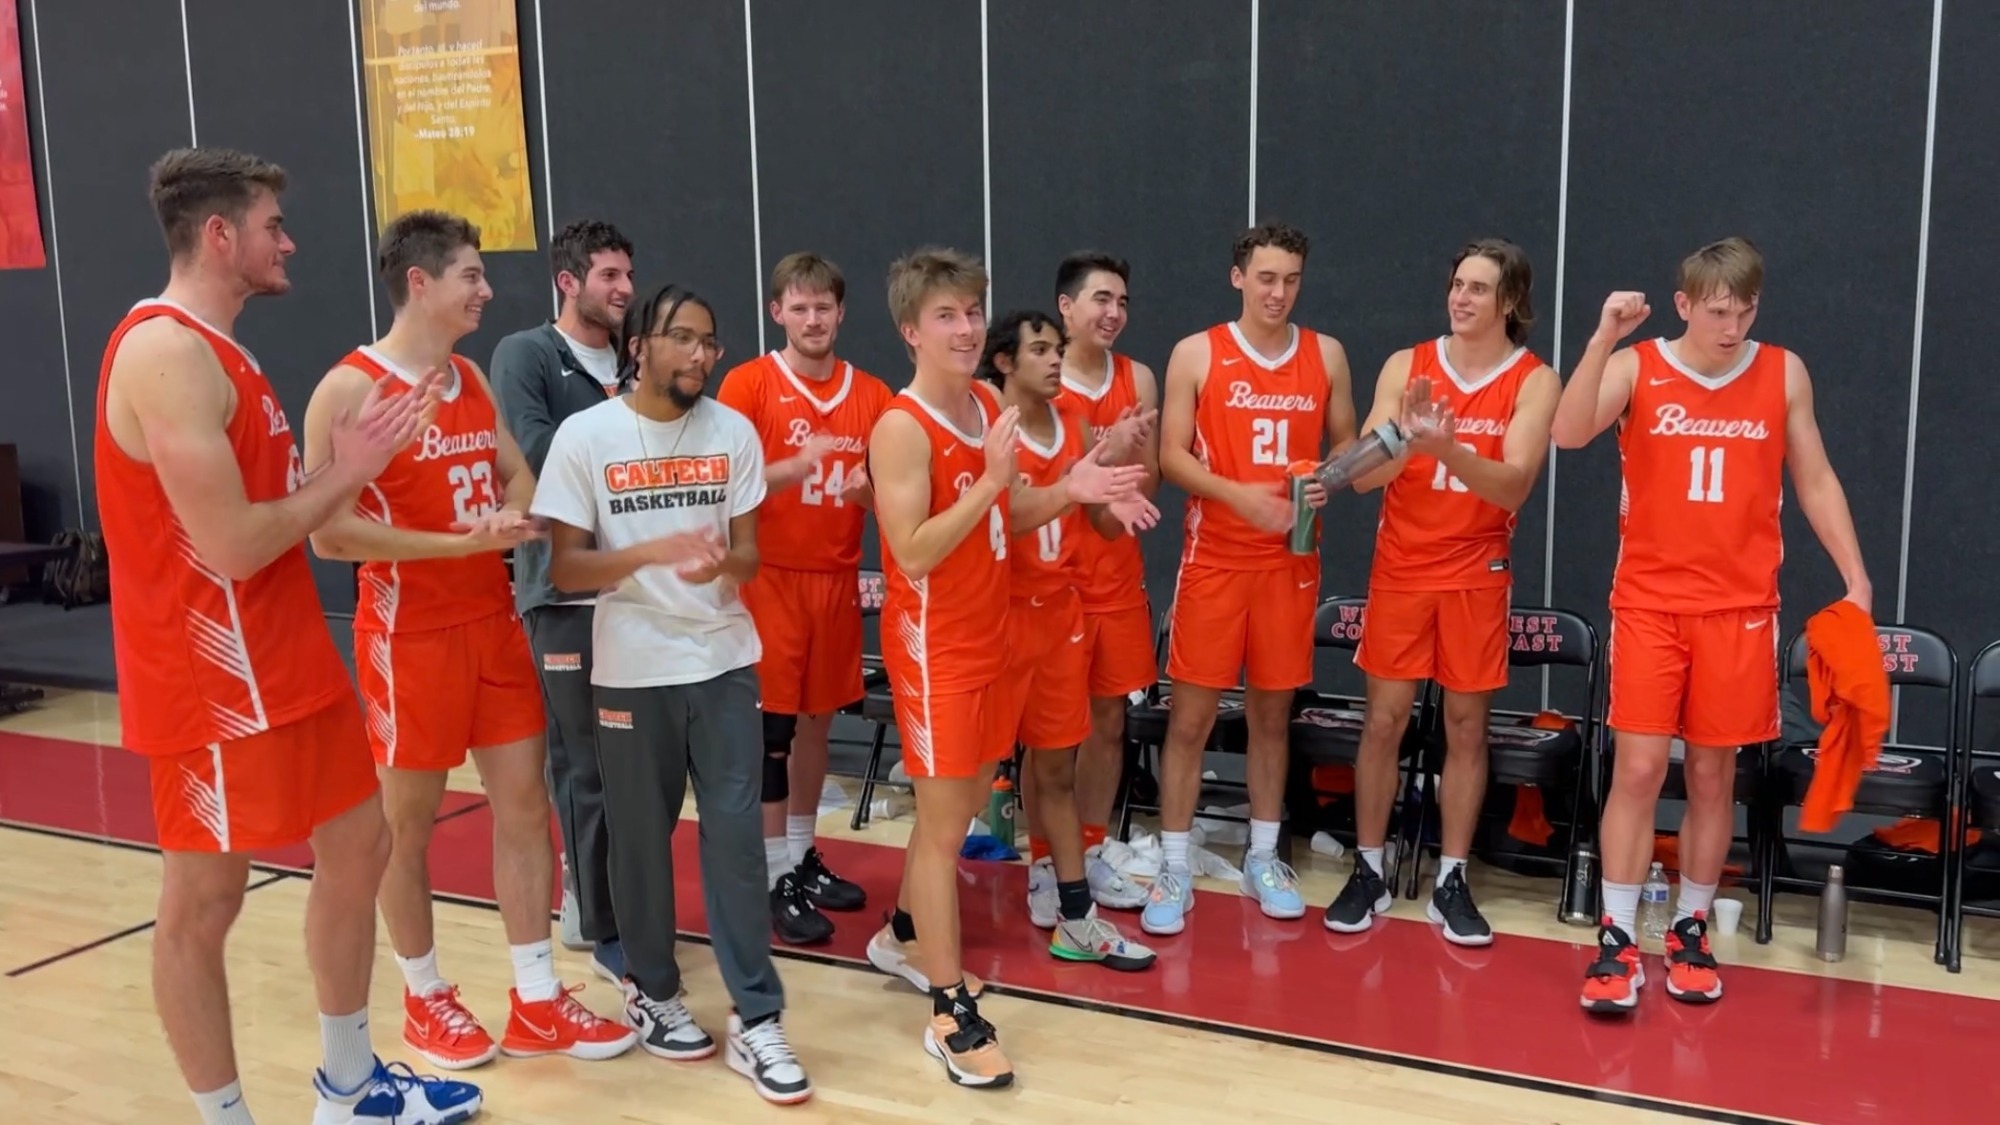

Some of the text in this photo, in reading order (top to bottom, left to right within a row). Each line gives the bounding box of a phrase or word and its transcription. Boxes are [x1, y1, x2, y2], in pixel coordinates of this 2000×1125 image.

[414, 3, 428, 13] del
[456, 39, 483, 51] haced
[403, 102, 416, 112] del
[444, 99, 458, 109] del
[450, 84, 464, 94] del
[1225, 381, 1317, 411] Beavers
[1649, 403, 1769, 440] Beavers
[414, 424, 497, 461] Beaver
[1252, 418, 1289, 465] 21
[605, 454, 730, 493] CALTECH
[801, 457, 844, 508] 24
[1687, 446, 1725, 503] 11
[448, 460, 497, 523] 23
[609, 489, 727, 515] BASKETBALL
[1510, 616, 1557, 633] EST
